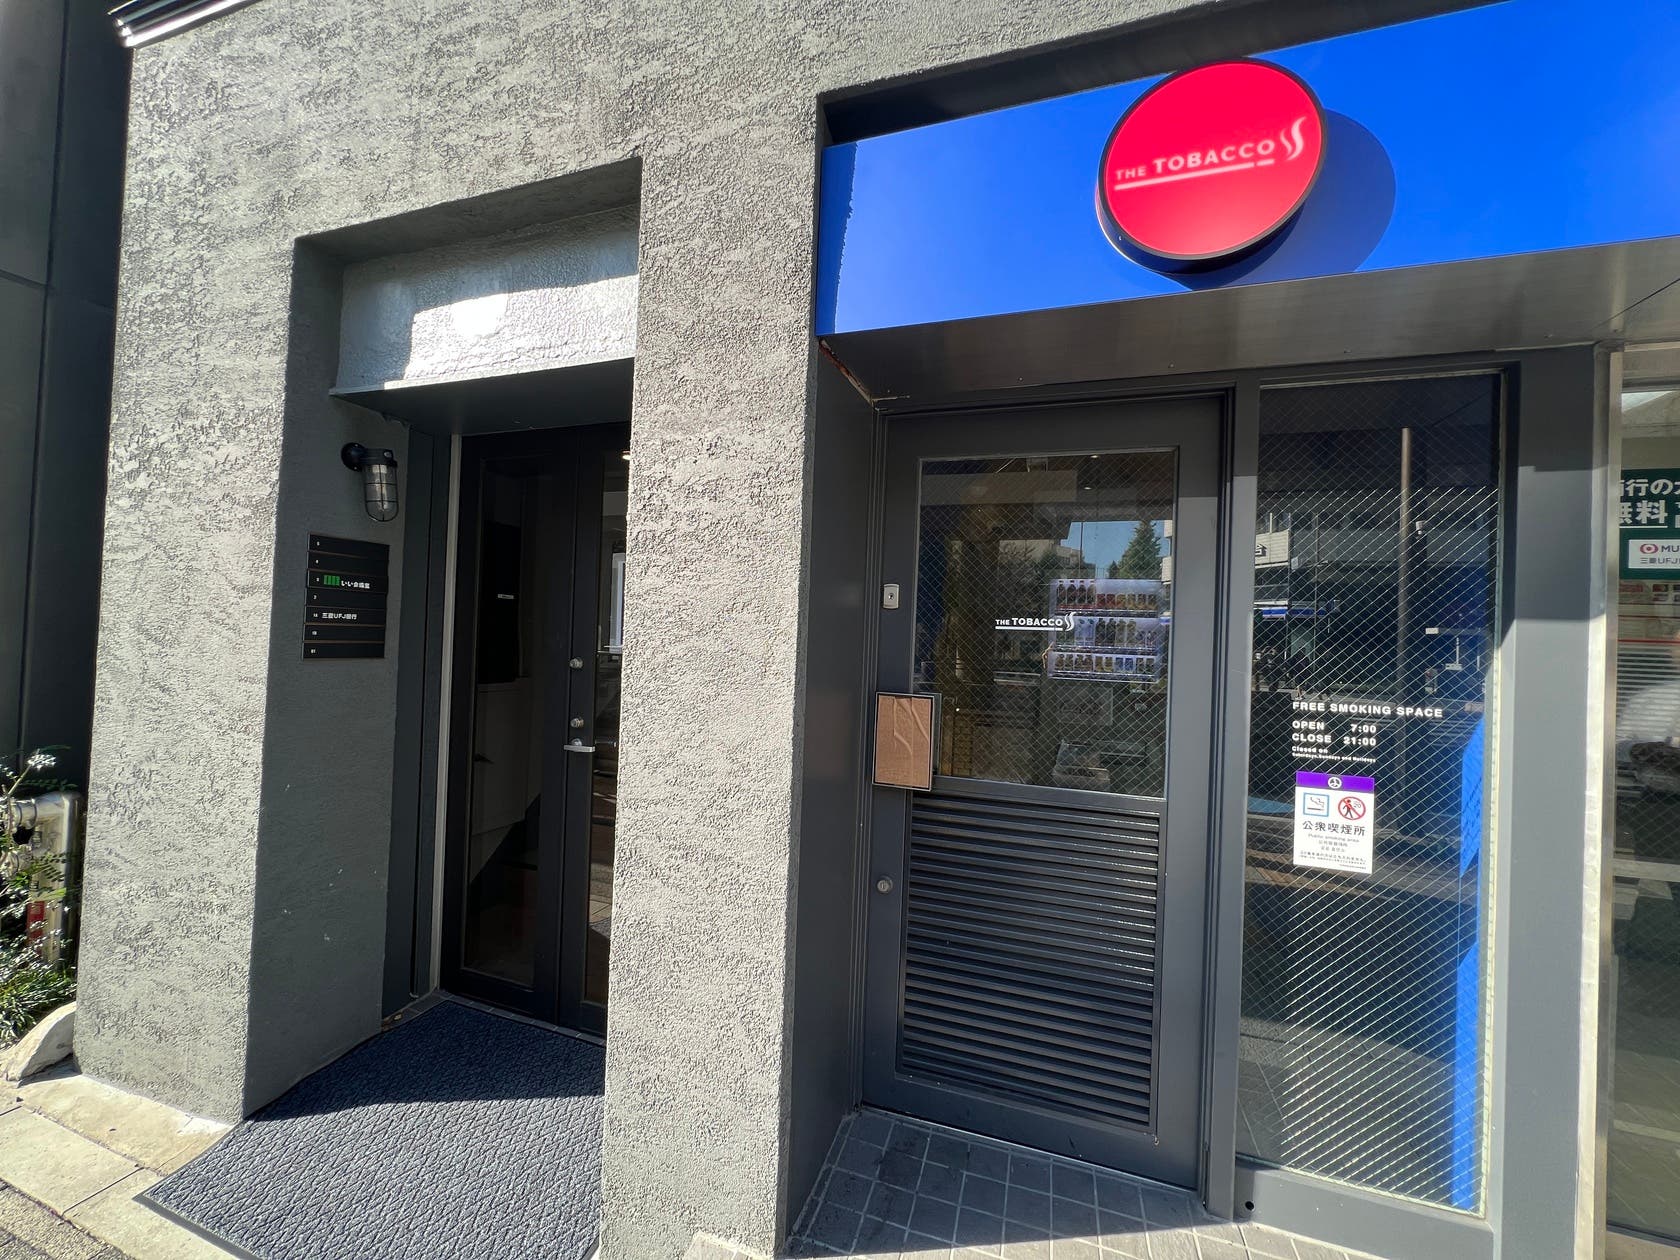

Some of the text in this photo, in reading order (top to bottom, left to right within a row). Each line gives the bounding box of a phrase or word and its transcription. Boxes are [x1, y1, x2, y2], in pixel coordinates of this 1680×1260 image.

[1115, 139, 1275, 181] THE TOBACCO
[1620, 478, 1680, 496] 行の
[1012, 617, 1063, 626] TOBACCO
[1292, 701, 1443, 718] FREE SMOKING SPACE
[1292, 720, 1377, 733] OPEN 7:00
[1292, 732, 1377, 746] CLOSE 21:00
[1291, 745, 1317, 753] Closed
[1302, 820, 1366, 837] 公衆喫煙所
